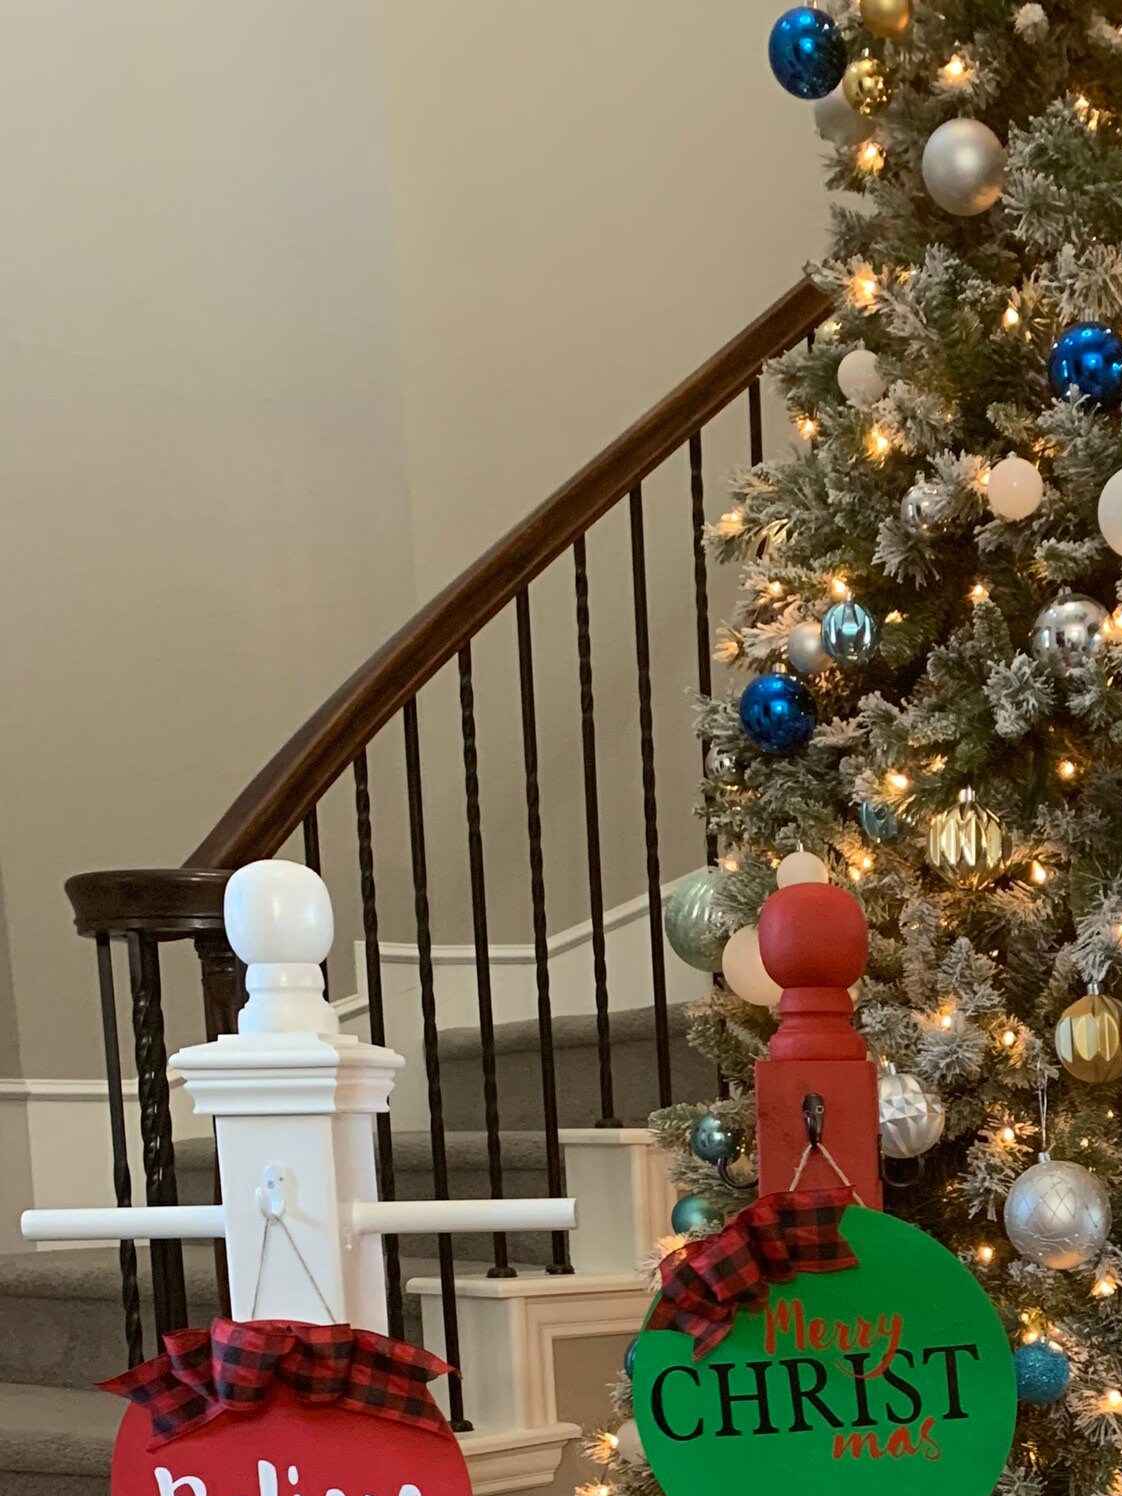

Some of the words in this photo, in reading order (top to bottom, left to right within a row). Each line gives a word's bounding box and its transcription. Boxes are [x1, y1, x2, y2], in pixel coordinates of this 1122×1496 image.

[760, 1298, 903, 1379] Merry
[650, 1343, 981, 1443] CHRIST
[831, 1416, 941, 1461] mas
